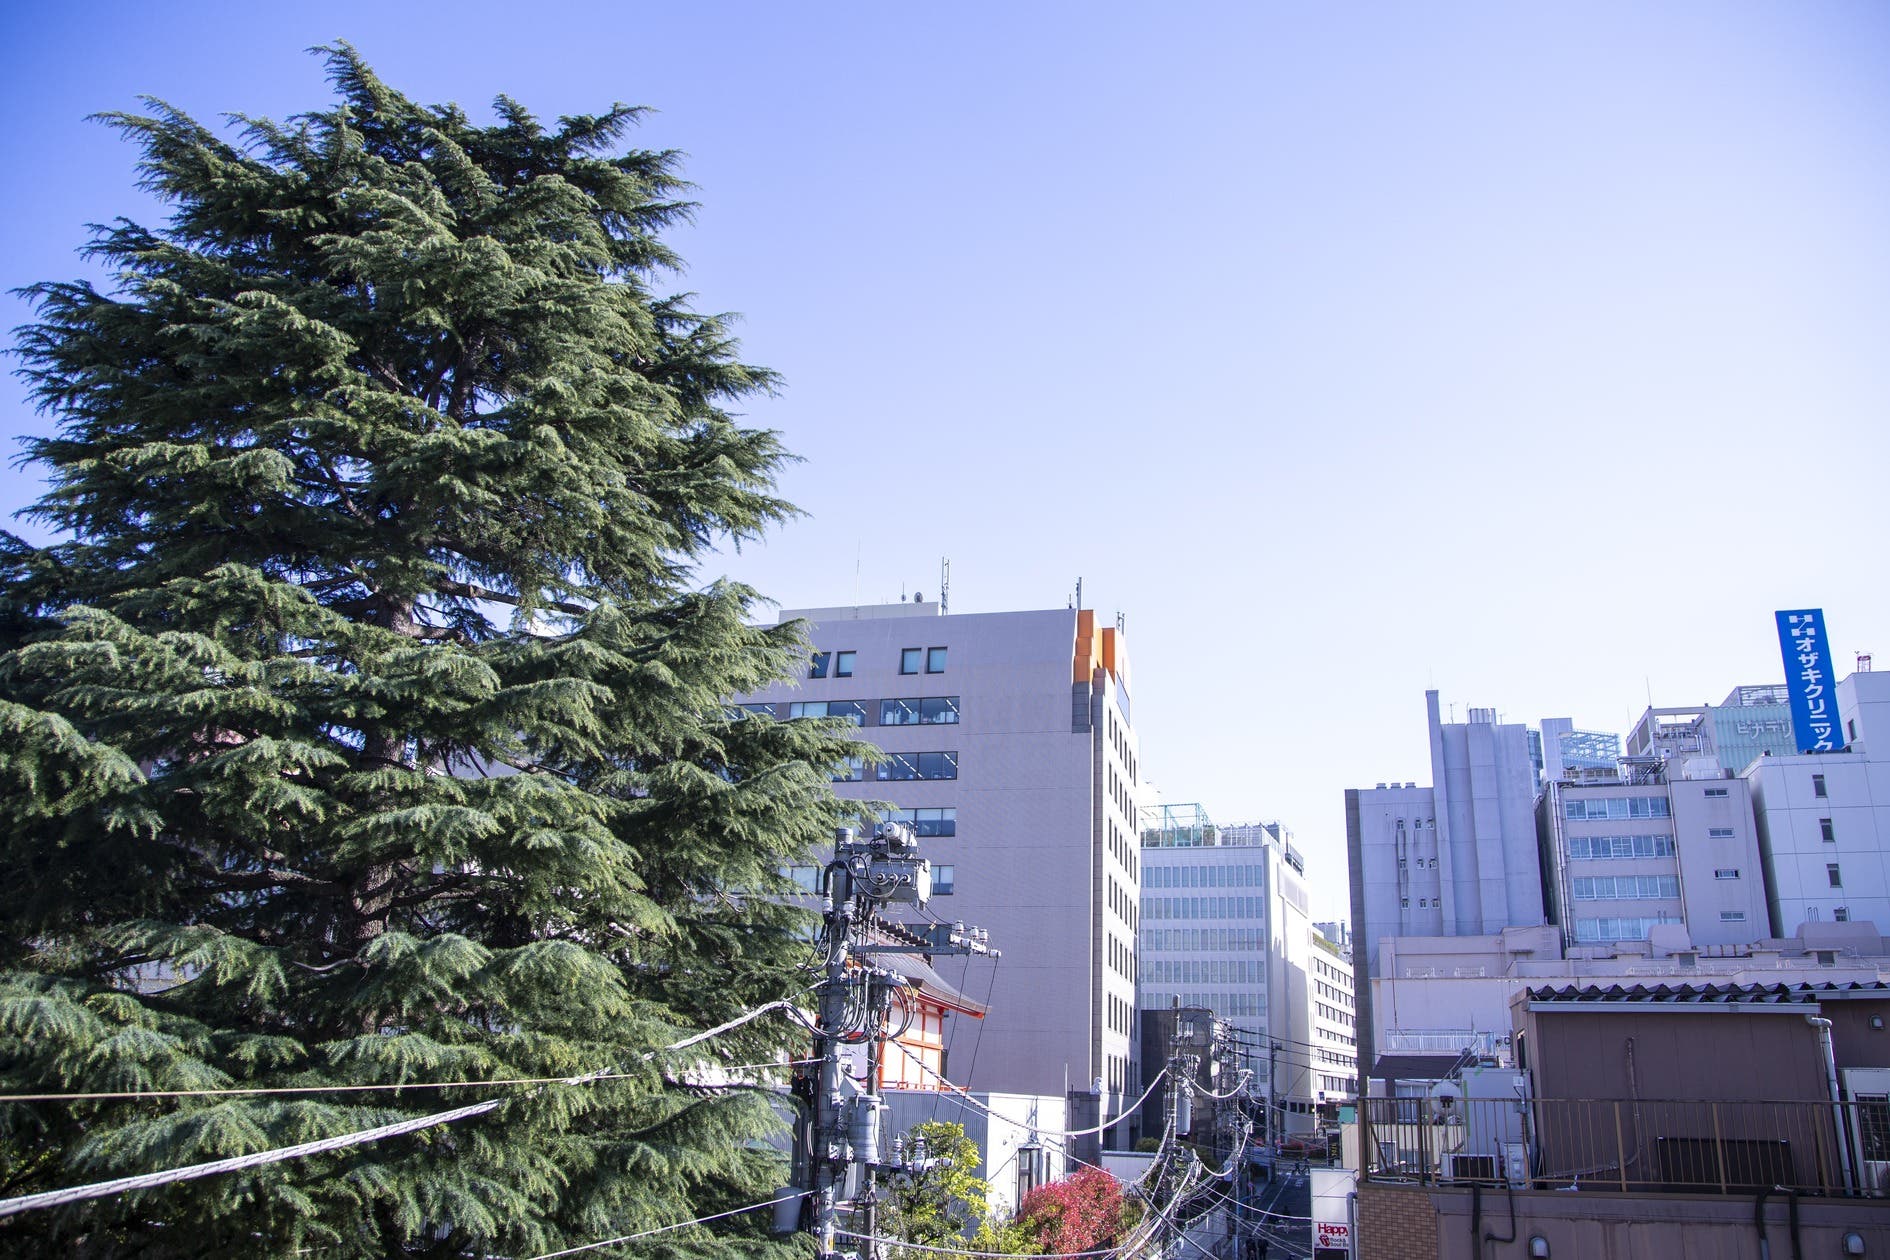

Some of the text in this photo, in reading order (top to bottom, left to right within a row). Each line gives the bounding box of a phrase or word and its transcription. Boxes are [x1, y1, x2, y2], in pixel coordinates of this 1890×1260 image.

[1796, 637, 1833, 752] オザキクリニック
[1318, 1223, 1348, 1236] Happy
